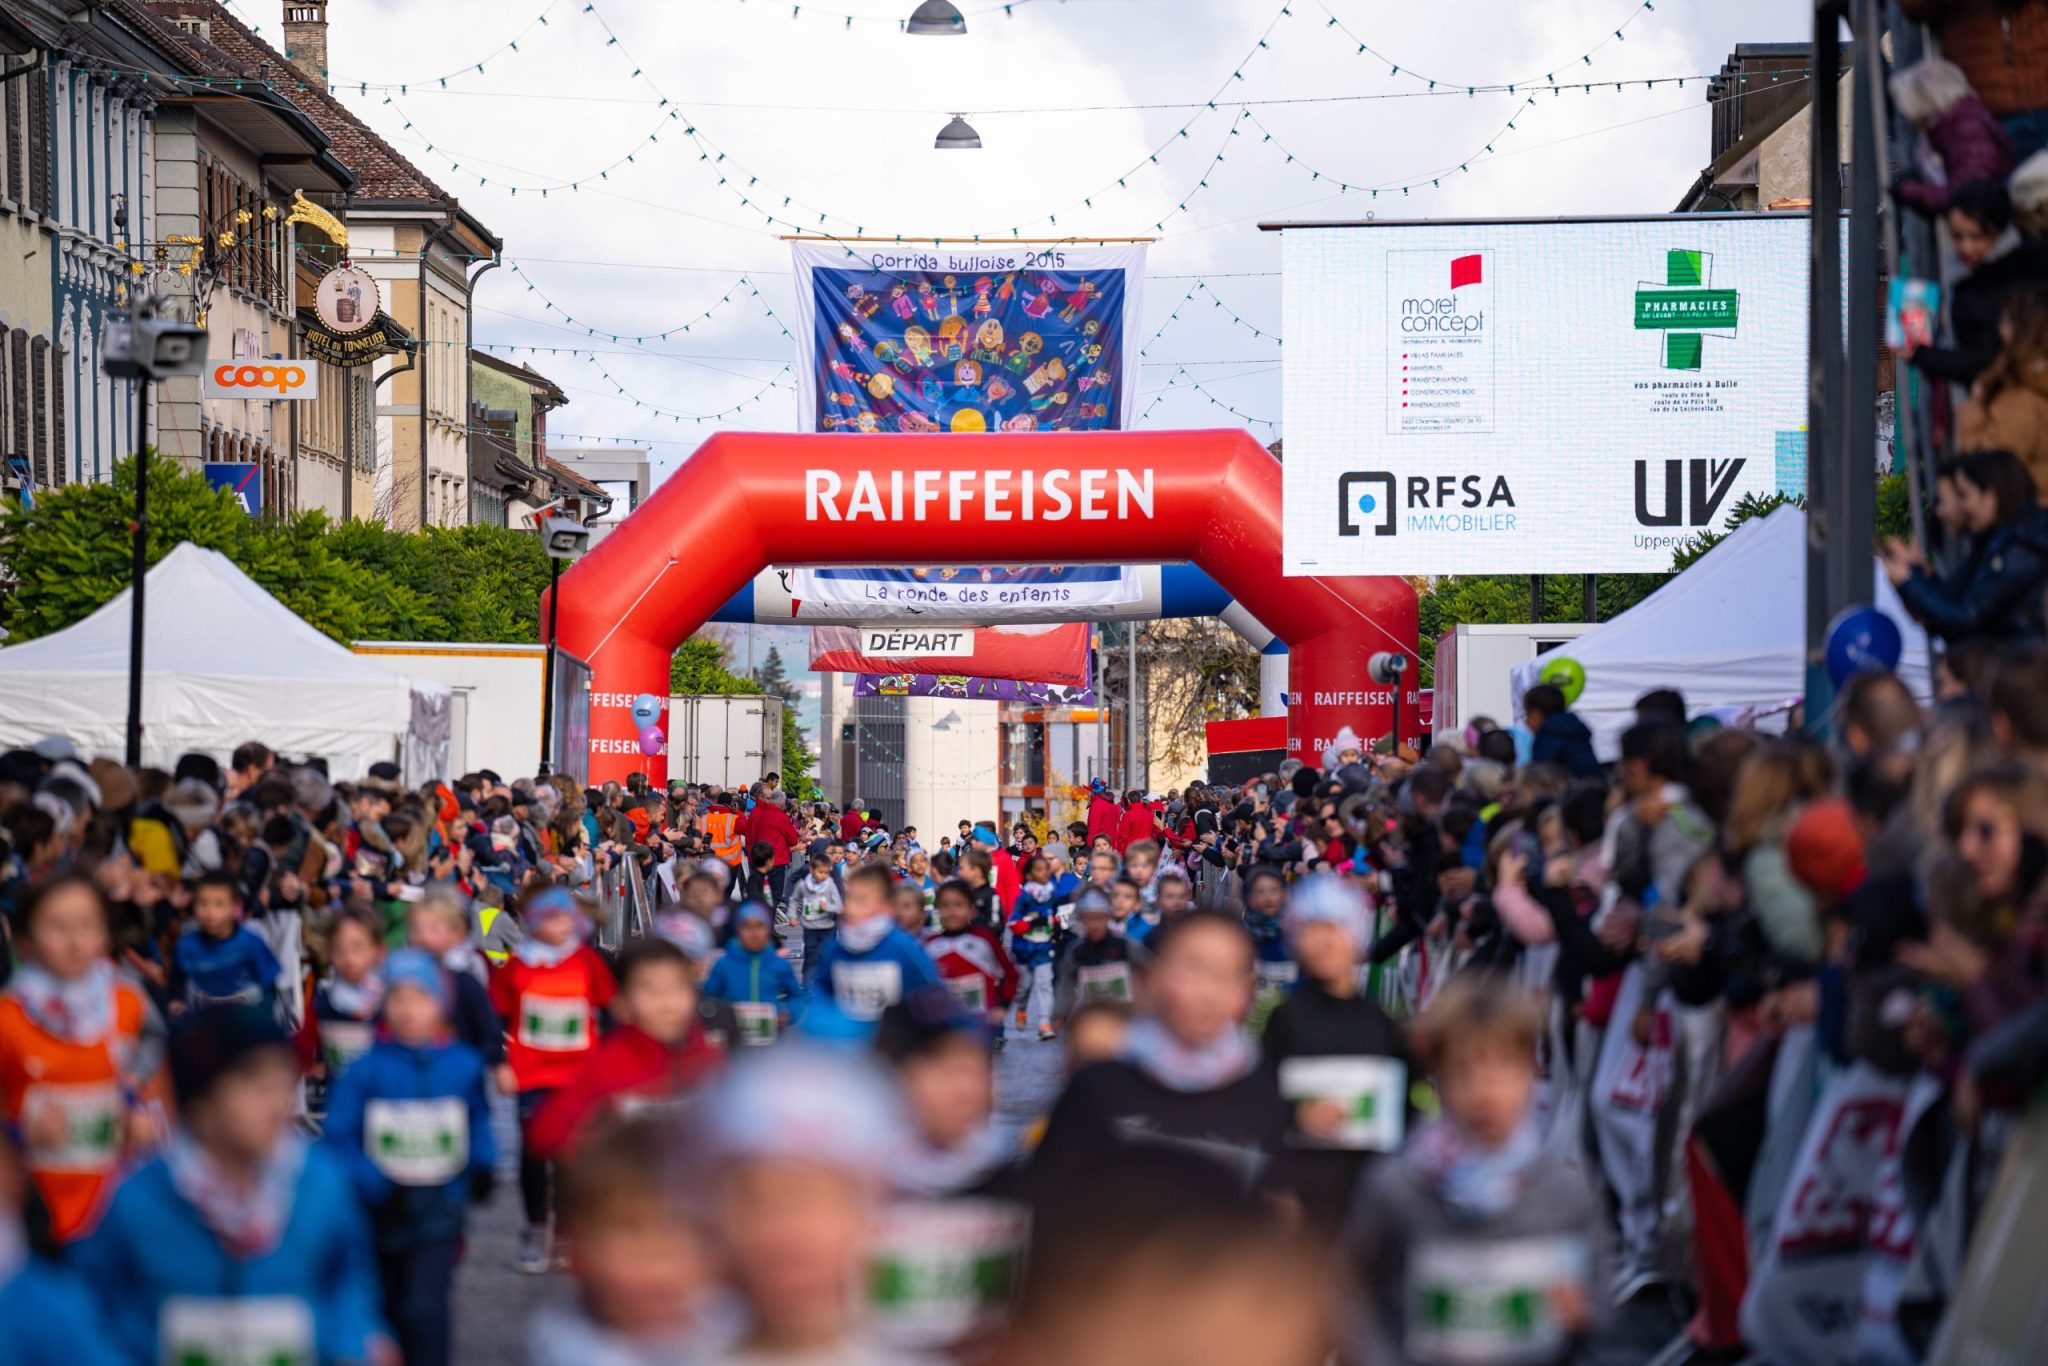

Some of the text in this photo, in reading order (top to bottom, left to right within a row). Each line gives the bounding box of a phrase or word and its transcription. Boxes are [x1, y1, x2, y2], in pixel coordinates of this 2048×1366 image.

[872, 252, 1066, 271] Corrida bulloise 2015
[1402, 293, 1458, 314] moret
[1644, 300, 1728, 312] PHARMACIES
[1401, 310, 1484, 336] concept
[306, 328, 331, 347] HOTEL
[343, 330, 386, 352] TONNELIER
[214, 364, 306, 394] coop
[1652, 381, 1703, 390] pharmacies
[1706, 380, 1711, 388] à
[1715, 380, 1738, 388] Bulle
[805, 468, 1155, 522] RAIFFEISEN
[1407, 474, 1516, 508] RFSA
[1407, 513, 1517, 532] IMMOBILIER
[864, 583, 1071, 603] La ronde des enfants
[869, 628, 963, 651] DÉPART
[1314, 691, 1395, 706] RAIFFEISEN
